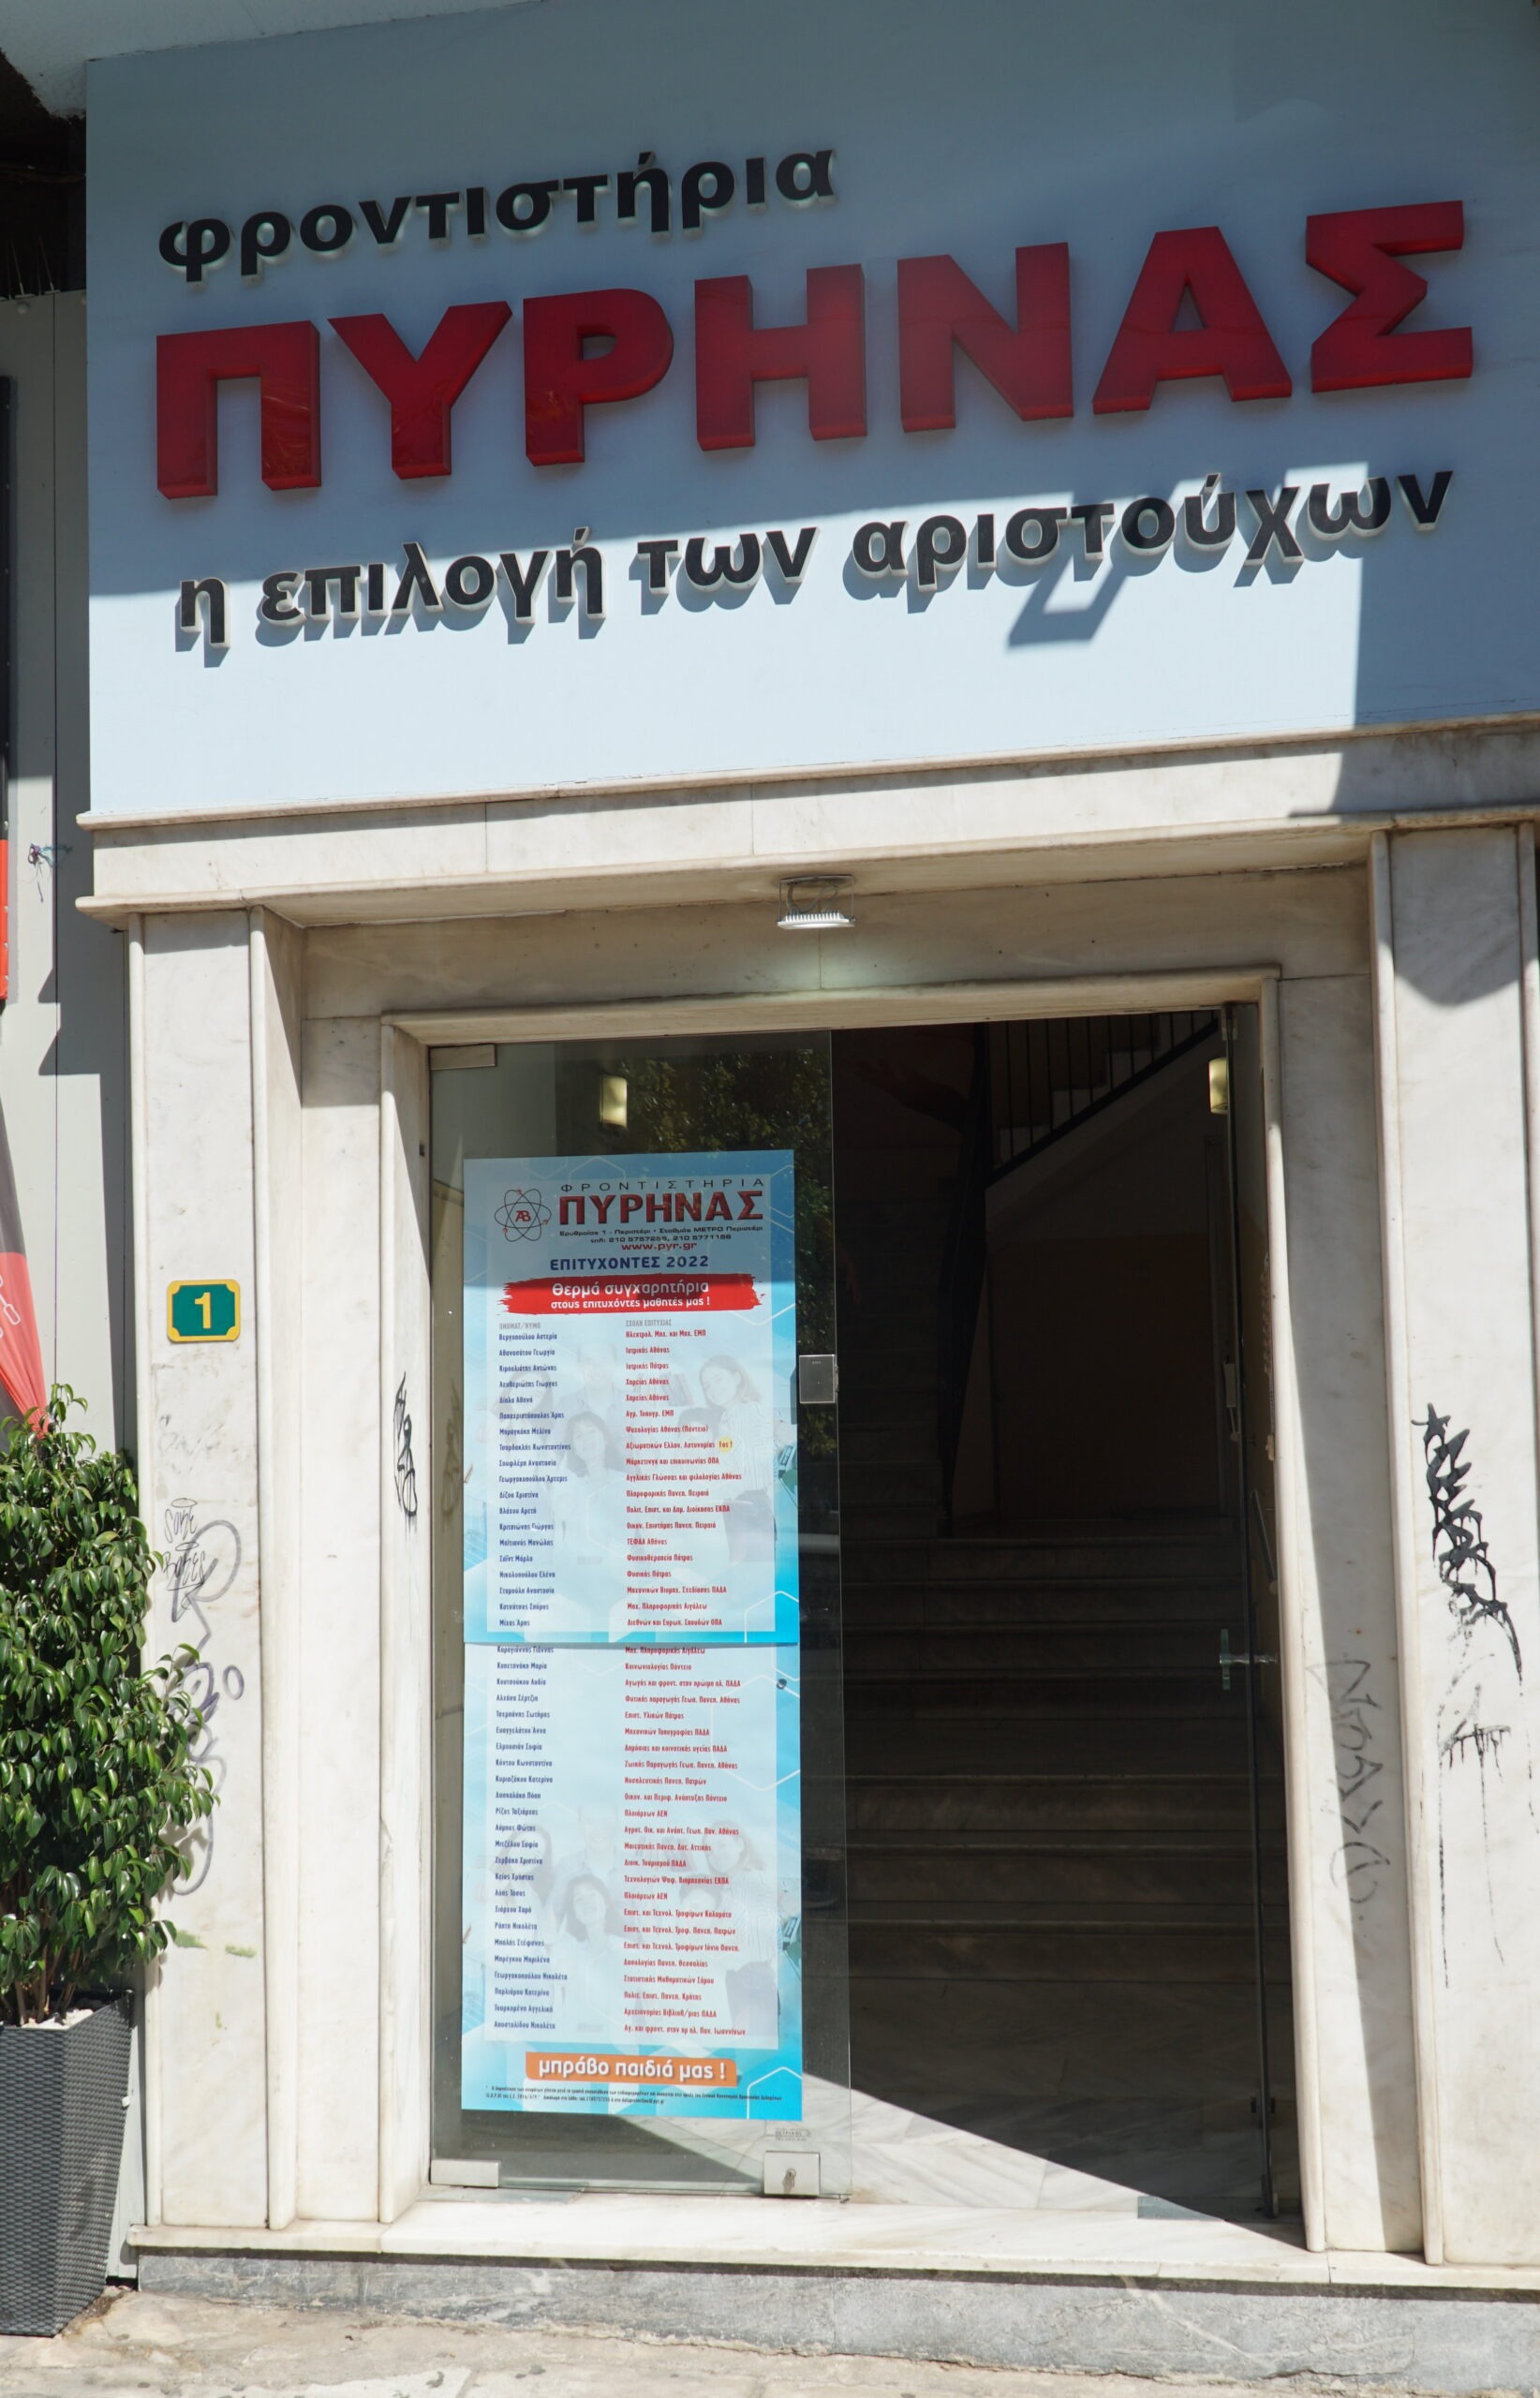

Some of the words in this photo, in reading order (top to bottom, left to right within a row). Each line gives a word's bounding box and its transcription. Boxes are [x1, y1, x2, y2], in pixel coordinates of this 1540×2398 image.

[158, 150, 836, 285] φροντιστήρια
[156, 200, 1473, 500] ΠΥΡΗΝΑΣ
[179, 574, 230, 648] η
[259, 526, 607, 626] επιλογή
[638, 526, 818, 592] των
[851, 470, 1454, 592] αριστούχων
[560, 1177, 764, 1192] ΦΡΟΝΤΙΣΤΗΡΙΑ
[558, 1191, 763, 1225] ΠΥΡΗΝΑΣ
[621, 1241, 698, 1251] www.pyr.gr
[550, 1256, 660, 1270] ΕΠΙΤΥΧΟΝΤΕΣ
[667, 1255, 709, 1268] 2022
[552, 1281, 600, 1298] Θερμά
[604, 1280, 709, 1296] συγχαρητήρια
[193, 1292, 212, 1329] 1
[551, 1300, 580, 1310] στους
[583, 1297, 641, 1310] επιτυχόντες
[644, 1297, 683, 1309] μαθητές
[686, 1298, 703, 1309] μας
[539, 2056, 610, 2078] μπράβο
[615, 2058, 674, 2077] παιδιά
[679, 2063, 714, 2080] μας
